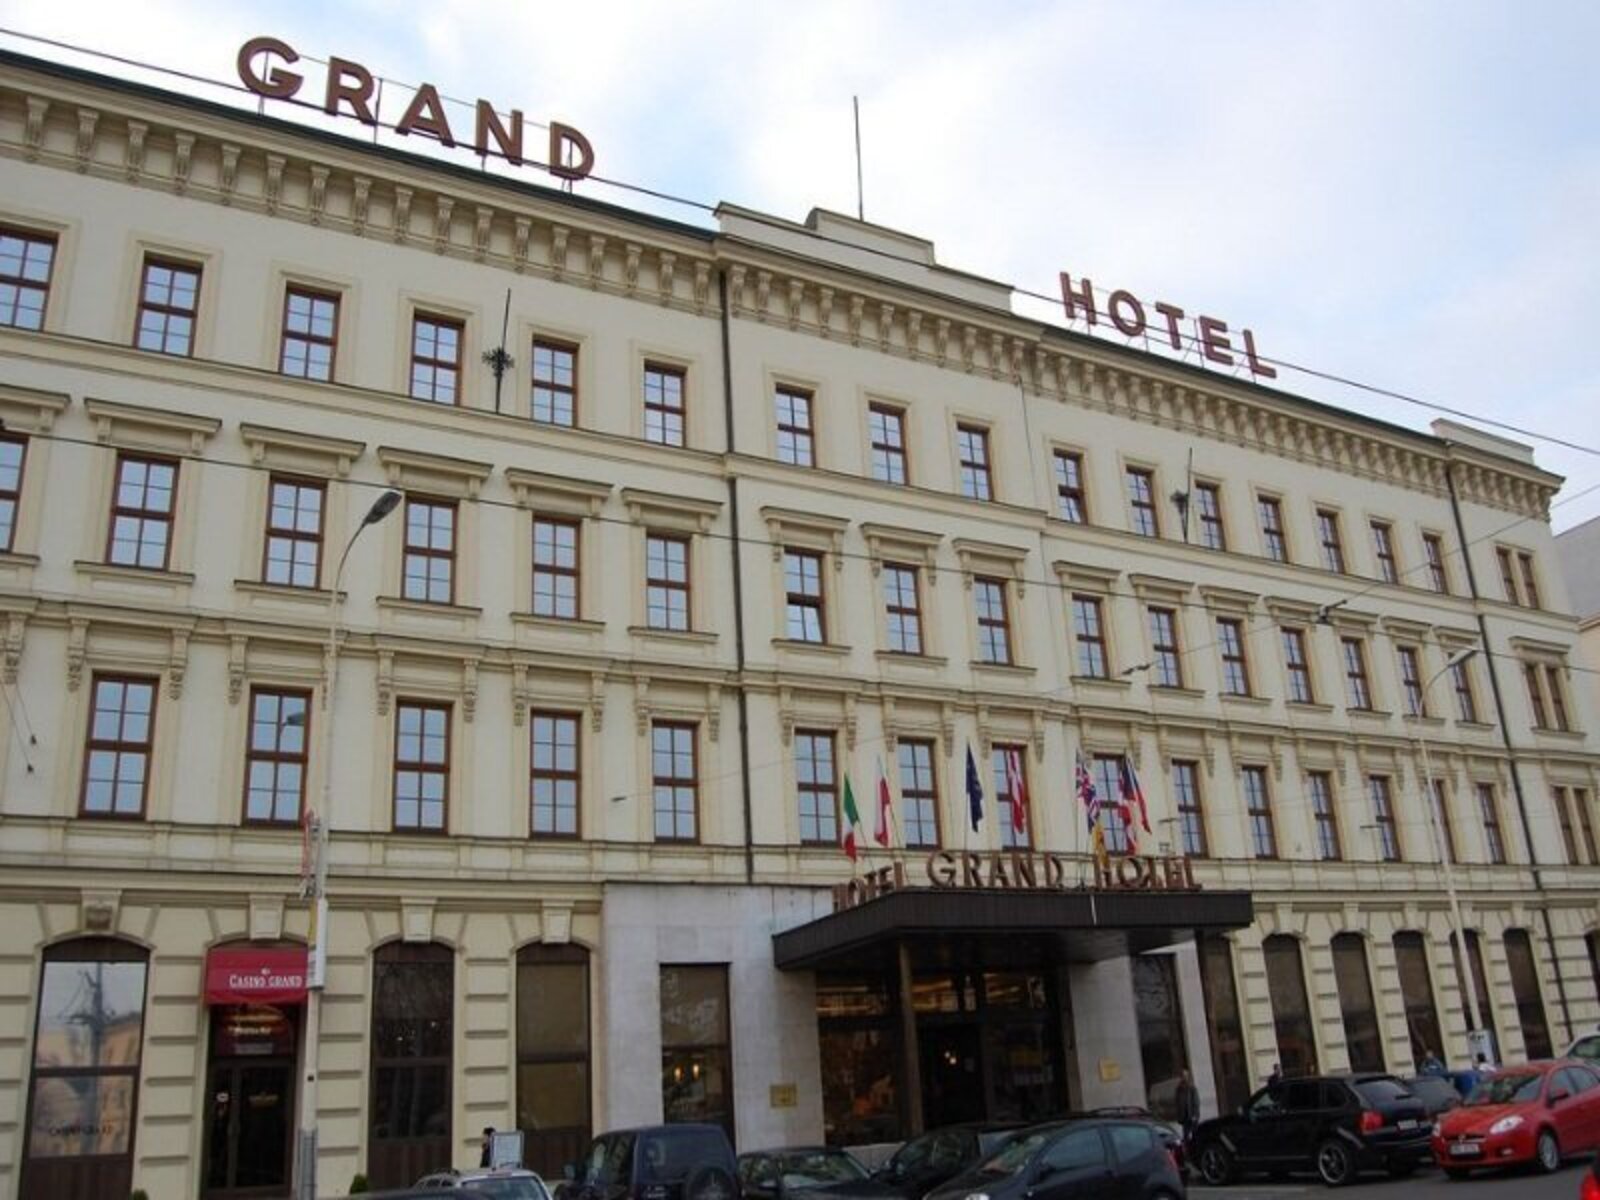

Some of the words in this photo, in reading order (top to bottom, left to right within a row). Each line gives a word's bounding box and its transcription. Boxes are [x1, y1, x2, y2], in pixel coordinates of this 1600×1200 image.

[237, 36, 594, 180] GRAND
[1059, 271, 1277, 379] HOTEL
[832, 861, 904, 914] HOTEL
[927, 852, 1064, 889] GRAND
[1093, 853, 1202, 891] HOTEL
